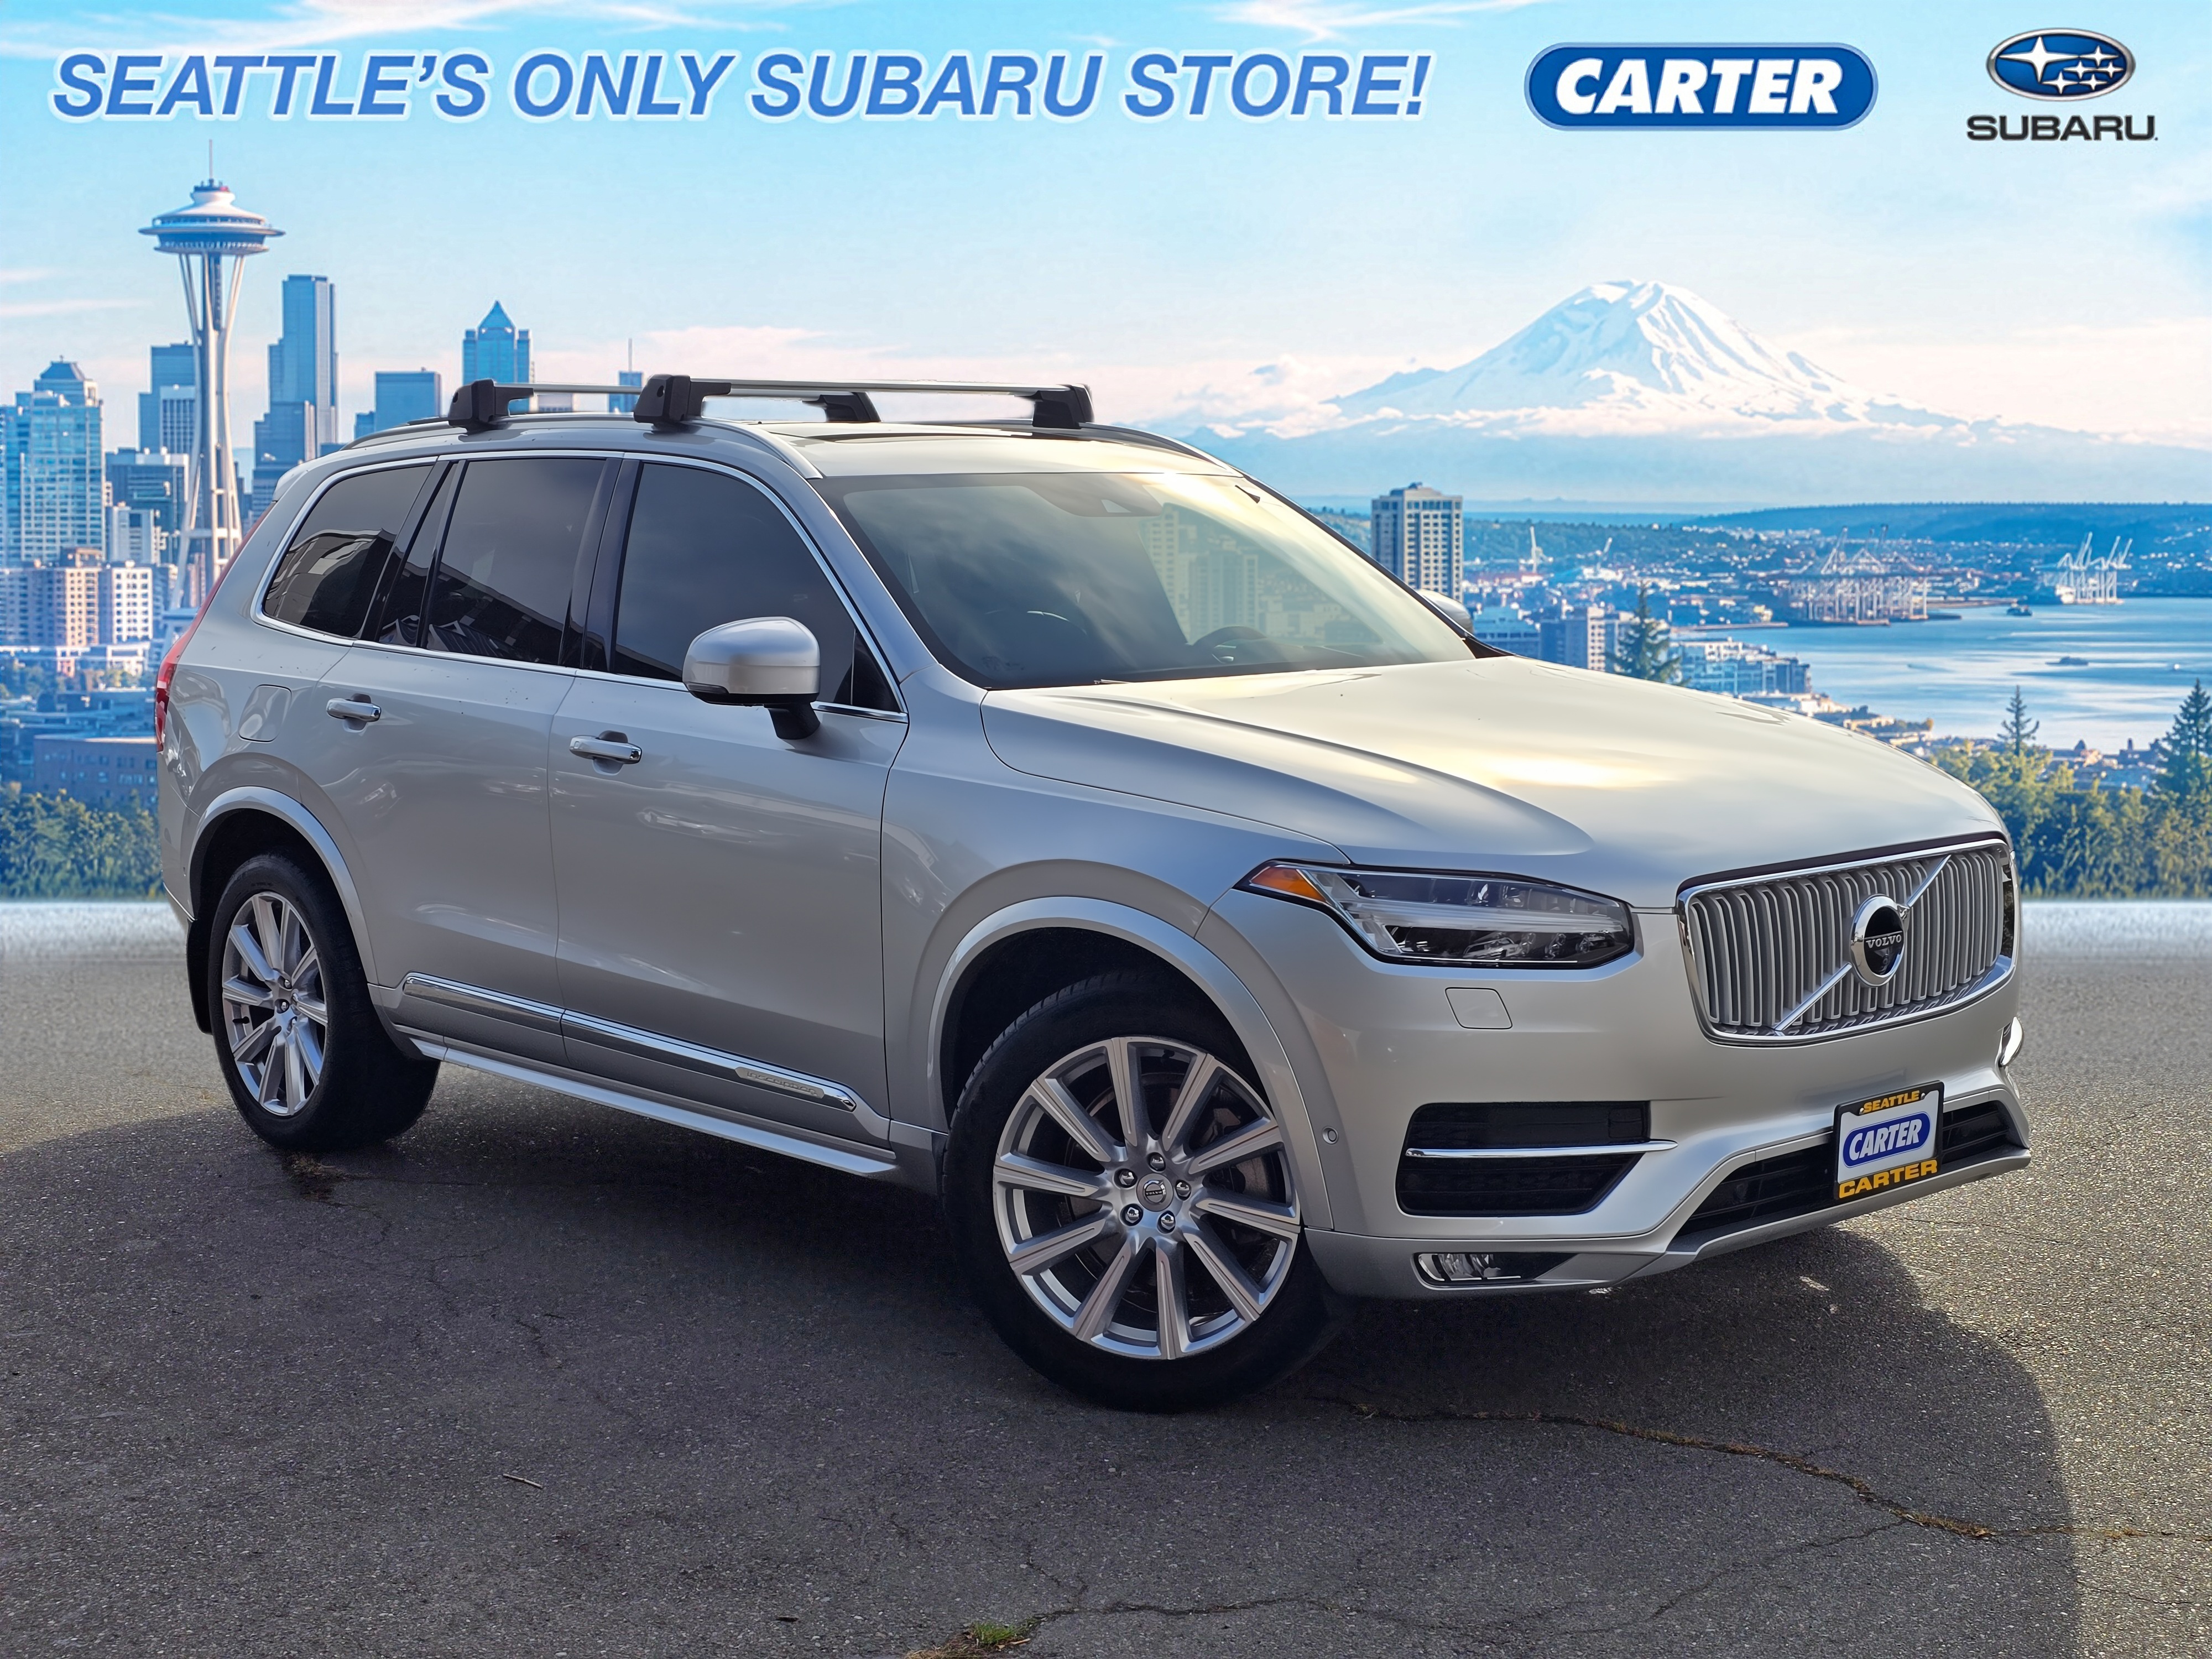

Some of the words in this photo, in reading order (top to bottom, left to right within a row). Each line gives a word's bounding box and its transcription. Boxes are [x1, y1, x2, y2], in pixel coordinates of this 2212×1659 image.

[1865, 934, 1902, 949] VOLVO
[1863, 1090, 1920, 1114] SEATTLE
[1849, 1119, 1922, 1161] CARTER
[1839, 1159, 1938, 1199] CARTER
